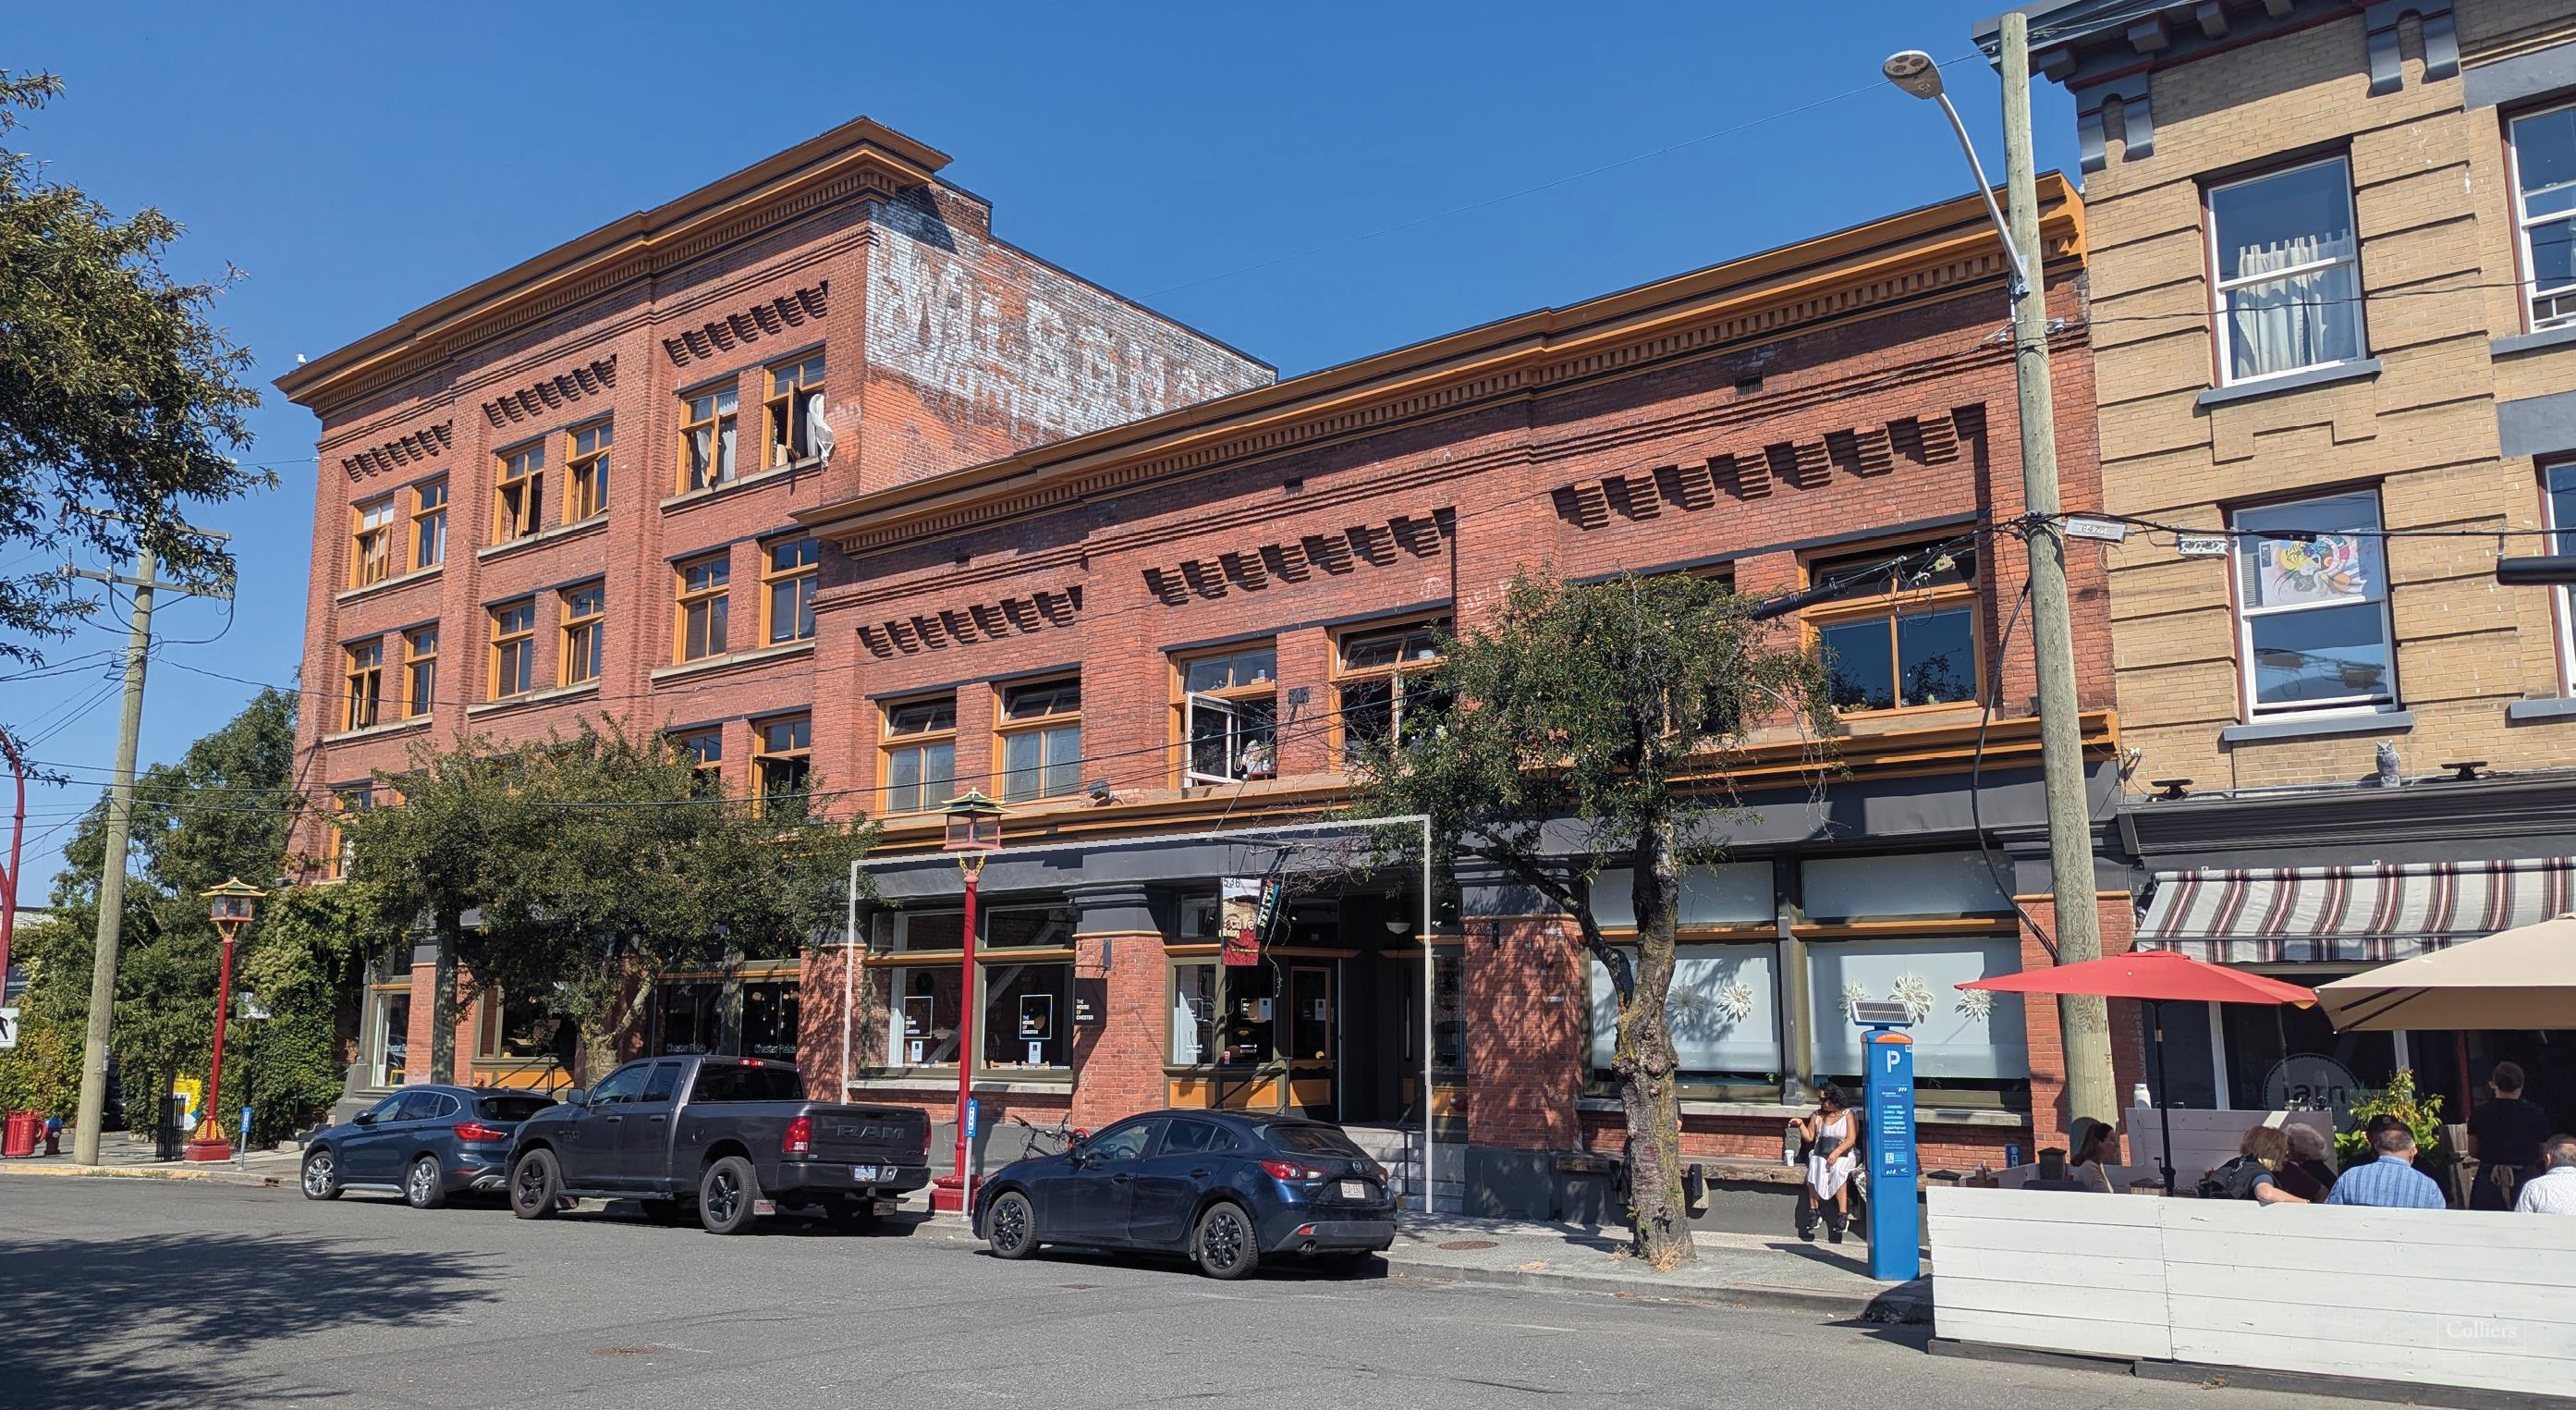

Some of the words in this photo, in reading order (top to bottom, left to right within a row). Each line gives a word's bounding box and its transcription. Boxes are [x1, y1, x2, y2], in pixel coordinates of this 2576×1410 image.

[1223, 878, 1239, 889] 536
[754, 1044, 778, 1054] Chester
[779, 1044, 797, 1054] Fields
[1886, 1049, 1901, 1073] P
[836, 1124, 905, 1141] RAM
